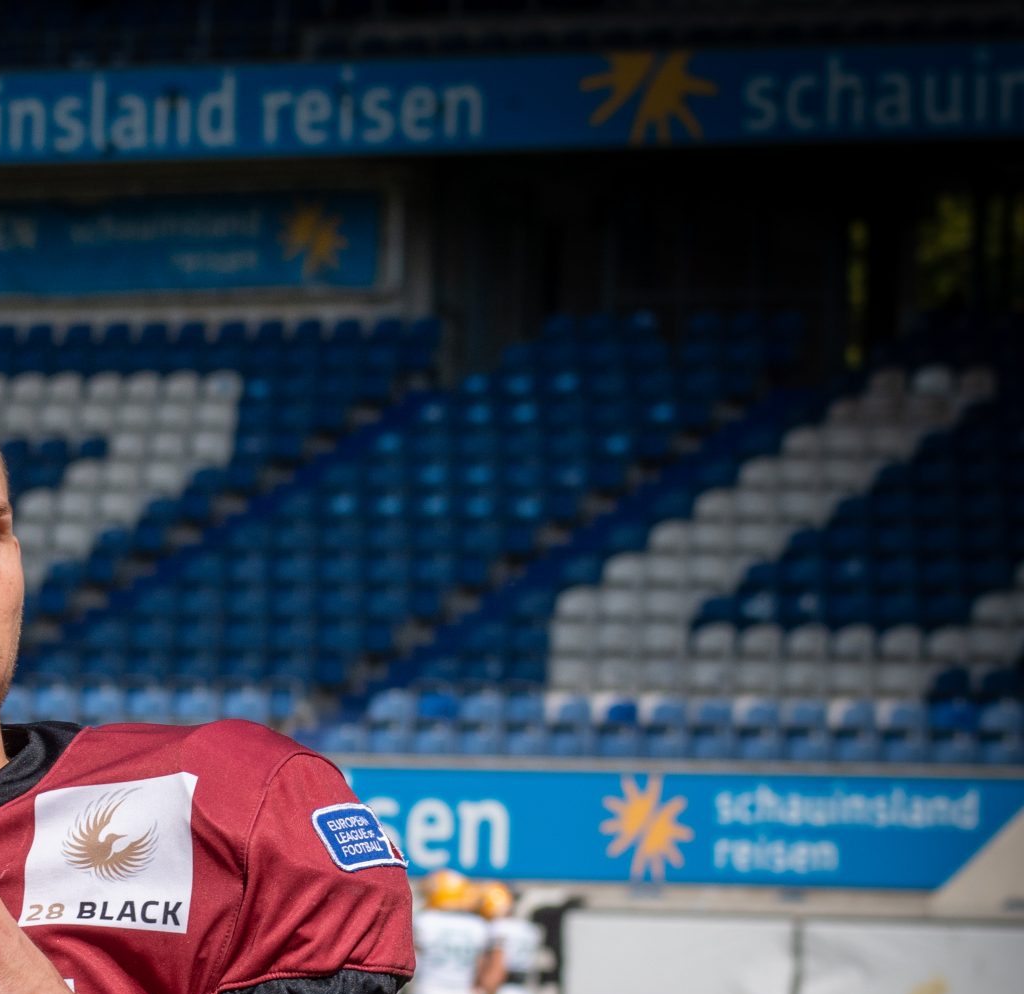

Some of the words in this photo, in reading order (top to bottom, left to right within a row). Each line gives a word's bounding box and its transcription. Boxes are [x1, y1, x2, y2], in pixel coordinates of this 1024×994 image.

[262, 68, 486, 147] reisen
[715, 785, 980, 829] schauinsland
[327, 815, 371, 832] EUROPEAN
[335, 828, 368, 845] LEAGUE
[362, 795, 511, 870] sen
[342, 841, 384, 857] FOOTBALL
[715, 836, 839, 872] reisen
[26, 902, 65, 921] 28
[76, 900, 182, 926] BLACK
